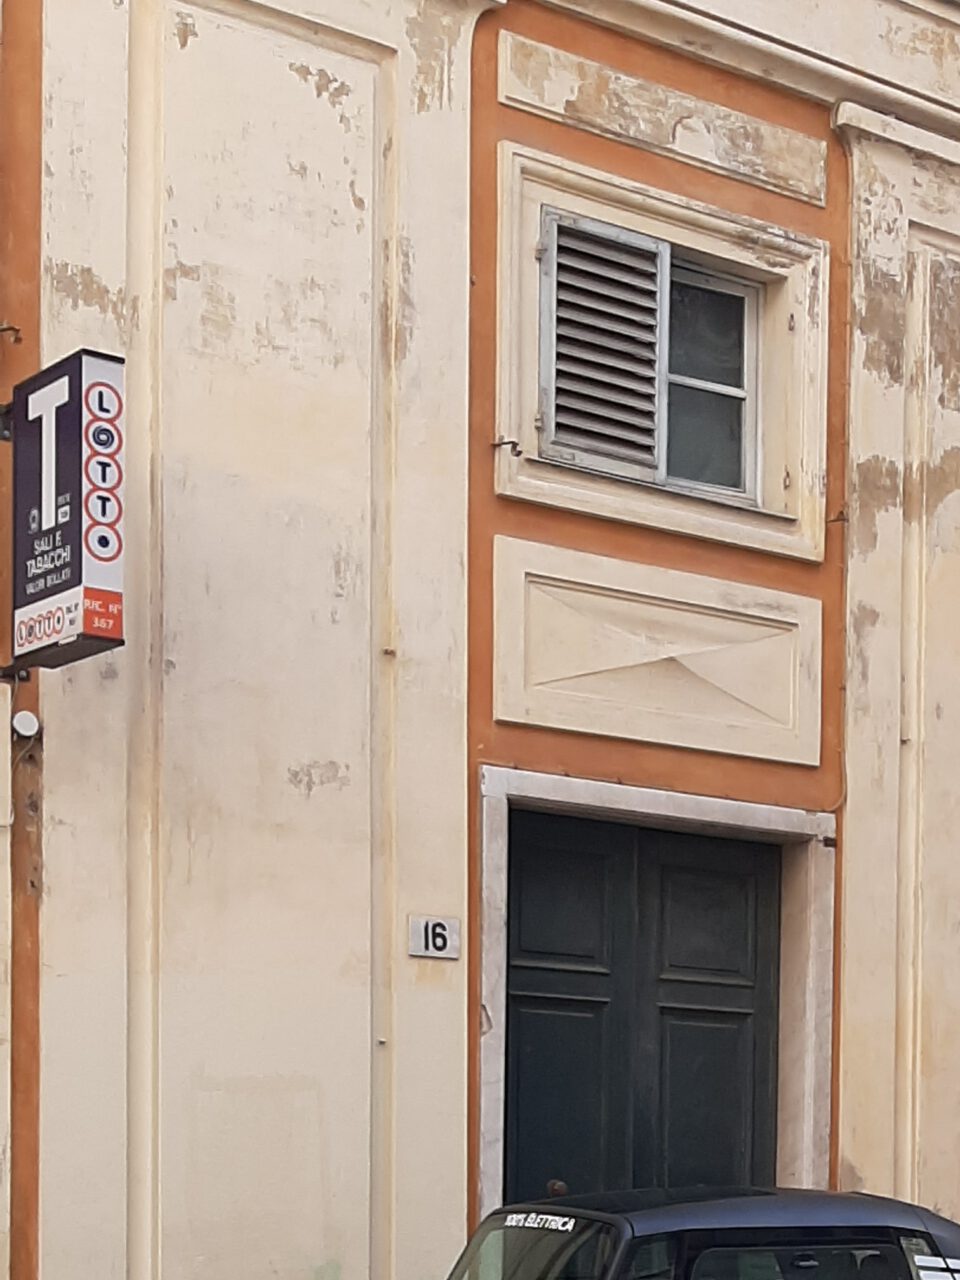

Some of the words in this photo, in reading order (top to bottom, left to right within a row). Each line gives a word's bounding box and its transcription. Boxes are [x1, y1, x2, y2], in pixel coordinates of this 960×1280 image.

[87, 387, 120, 557] LOTTO
[26, 545, 71, 578] TABACCHI
[424, 921, 448, 951] 16
